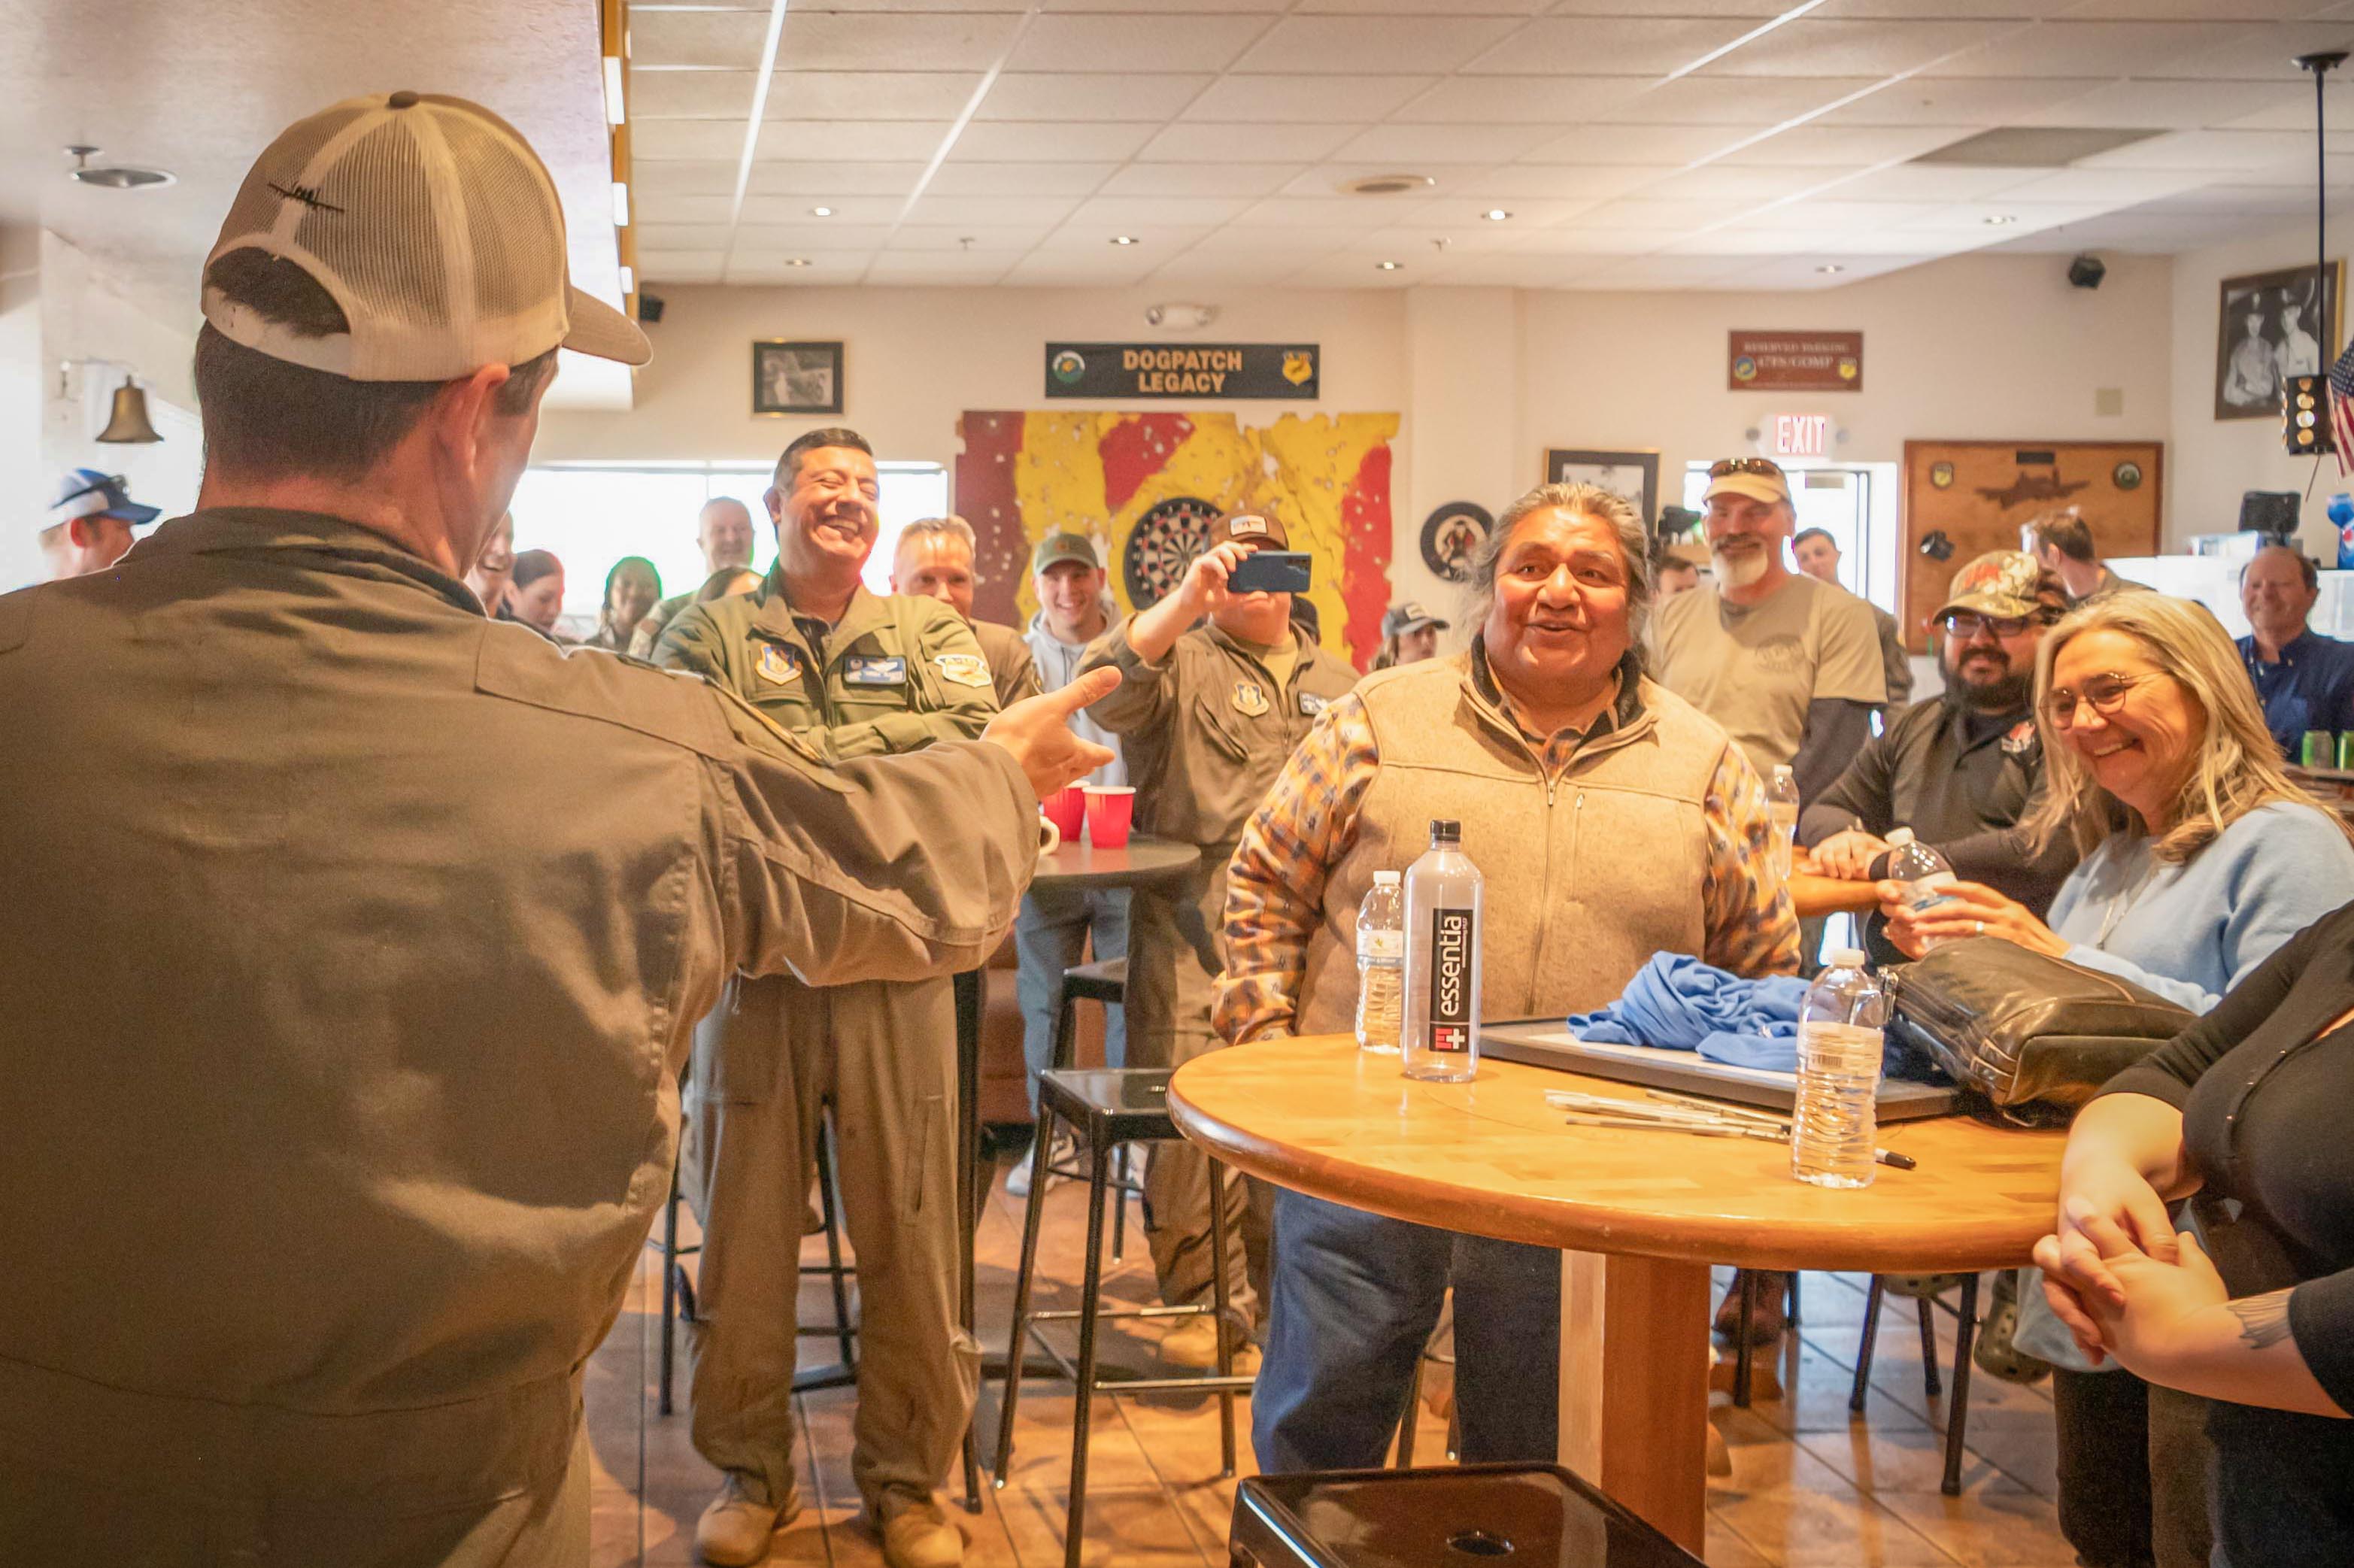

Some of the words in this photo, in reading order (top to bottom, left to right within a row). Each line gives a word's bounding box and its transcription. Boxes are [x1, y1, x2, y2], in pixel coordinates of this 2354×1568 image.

[1123, 350, 1242, 371] DOGPATCH
[1138, 372, 1227, 393] LEGACY
[1776, 415, 1825, 453] EXIT
[1439, 915, 1462, 1016] essentia
